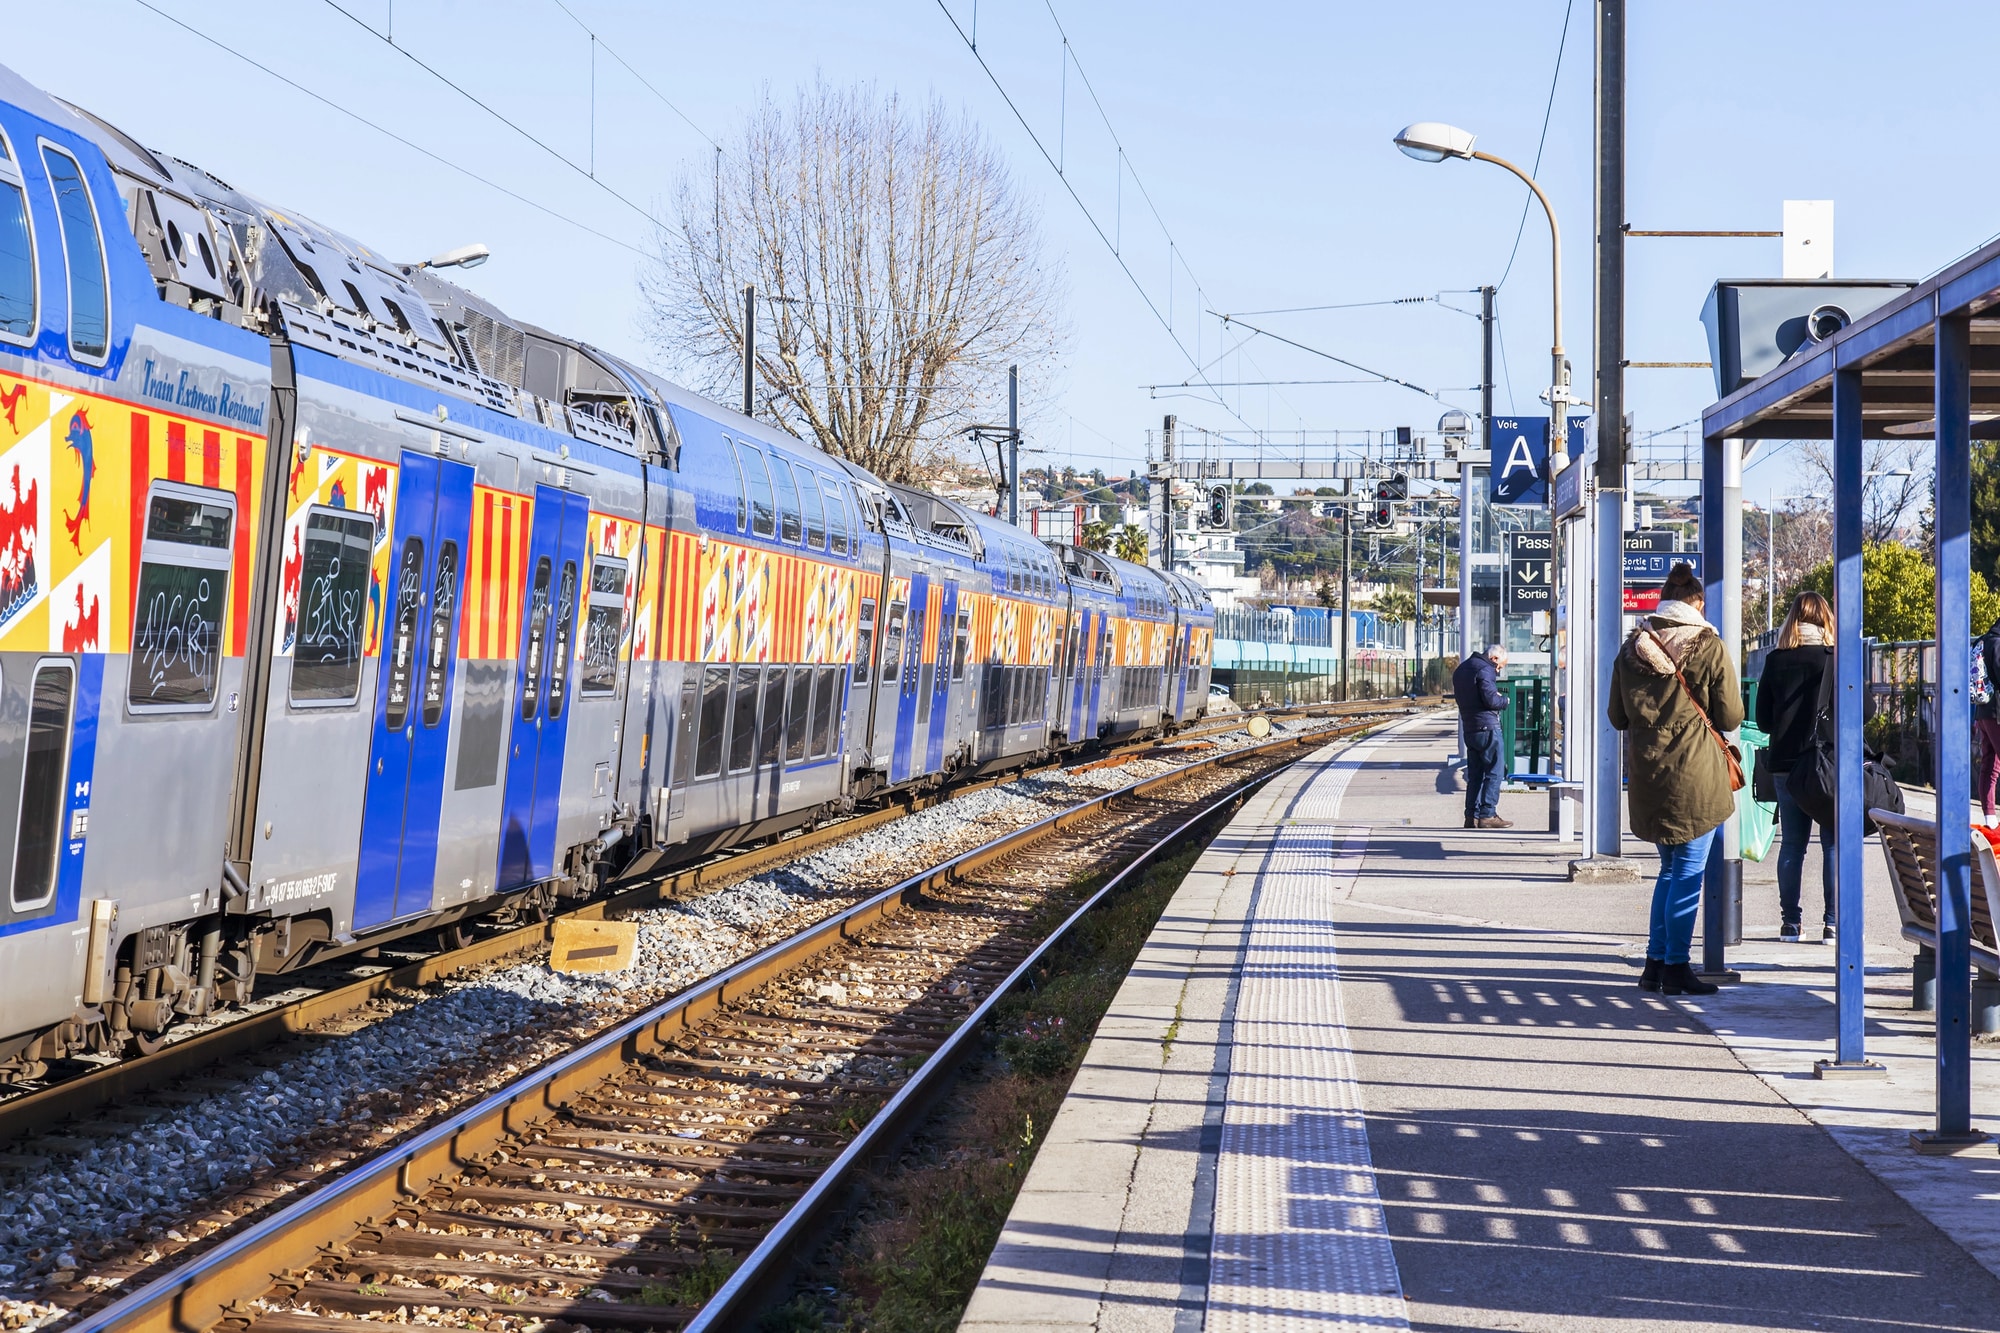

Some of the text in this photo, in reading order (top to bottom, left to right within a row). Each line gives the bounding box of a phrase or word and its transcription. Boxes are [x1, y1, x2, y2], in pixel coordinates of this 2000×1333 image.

[142, 357, 175, 402] Train
[218, 383, 265, 427] Régional
[1497, 419, 1518, 429] Voie
[1572, 419, 1585, 429] Vo
[1501, 435, 1538, 479] A
[1517, 535, 1552, 549] Pass
[1624, 557, 1646, 566] Sortie
[1517, 588, 1548, 599] Sortie
